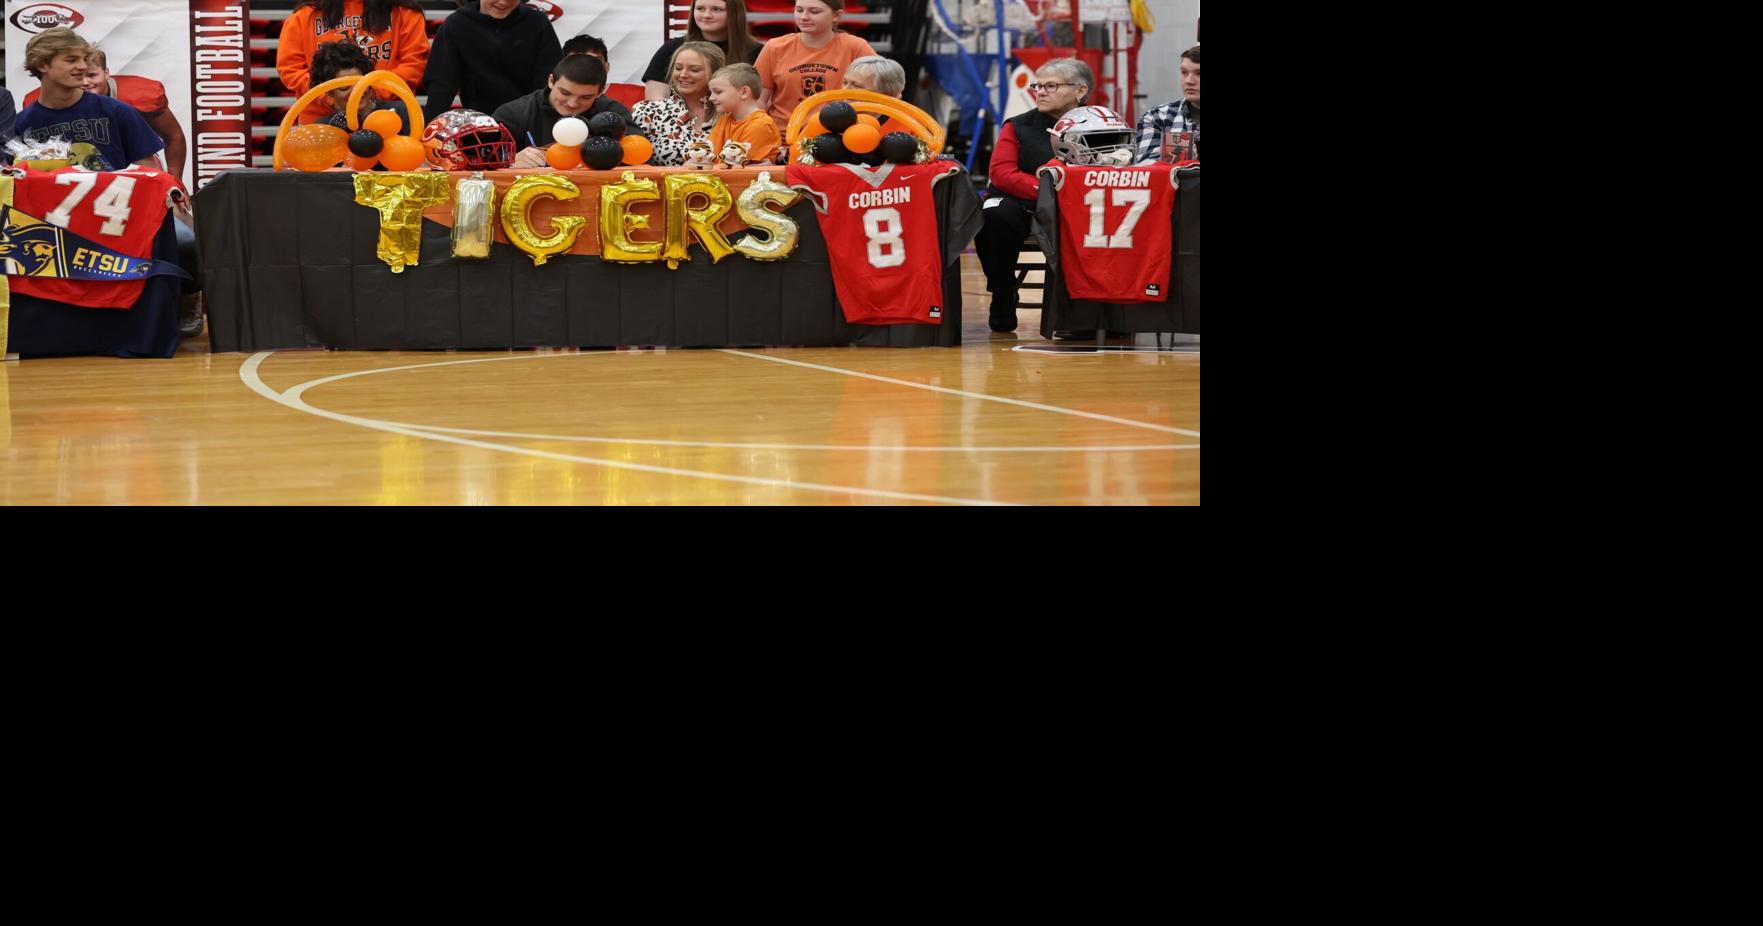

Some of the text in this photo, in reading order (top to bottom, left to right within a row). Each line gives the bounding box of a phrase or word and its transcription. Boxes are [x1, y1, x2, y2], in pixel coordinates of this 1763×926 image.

[36, 16, 54, 24] 100
[194, 6, 245, 122] FOOTBALL
[788, 63, 839, 73] GEORGETOWN
[848, 186, 911, 209] CORBIN
[1084, 170, 1151, 187] CORBIN
[45, 172, 137, 237] 74
[352, 171, 801, 273] TIGERS
[1083, 188, 1152, 249] 17
[862, 207, 906, 269] 8
[72, 247, 129, 274] ETSU
